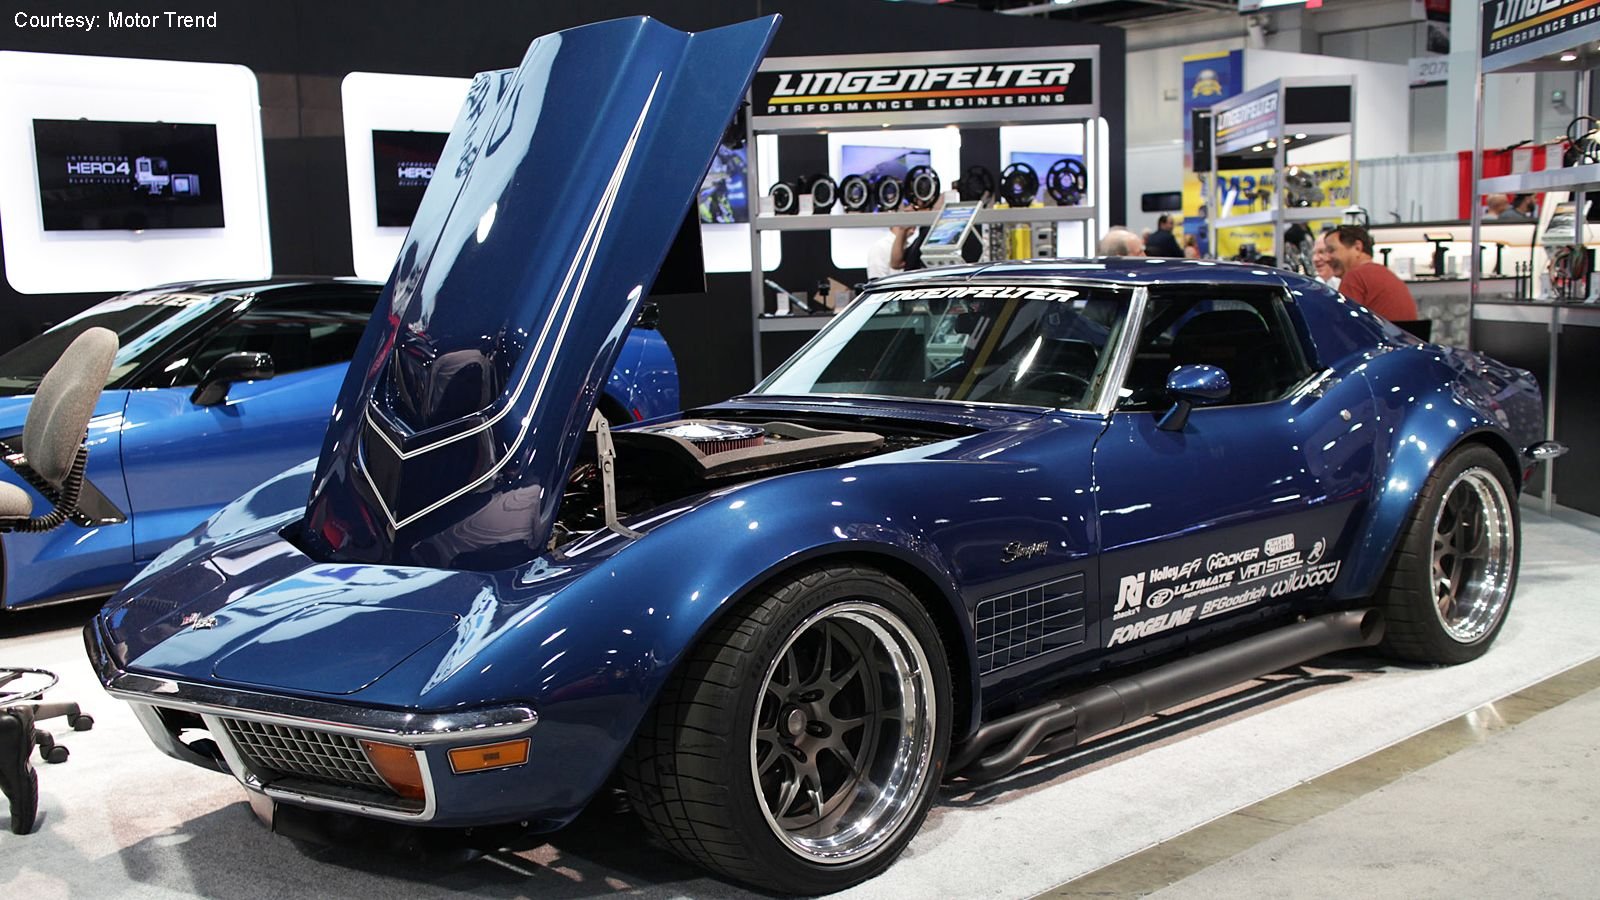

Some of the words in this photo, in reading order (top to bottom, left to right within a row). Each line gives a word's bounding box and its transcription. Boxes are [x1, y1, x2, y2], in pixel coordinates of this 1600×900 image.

[1489, 18, 1567, 52] PERFORMANCE
[773, 62, 1076, 97] LINGENFELTER
[767, 99, 914, 114] PERFORMANCE
[927, 93, 1066, 108] ENGINEERING
[67, 161, 130, 175] HERO4
[1207, 547, 1260, 573] HOOKER
[1149, 566, 1180, 583] Holley
[1174, 570, 1235, 596] ULTIMATE
[1270, 560, 1341, 598] wilwood
[1200, 585, 1267, 616] BFGoodrich
[1107, 605, 1198, 648] FORGELINE
